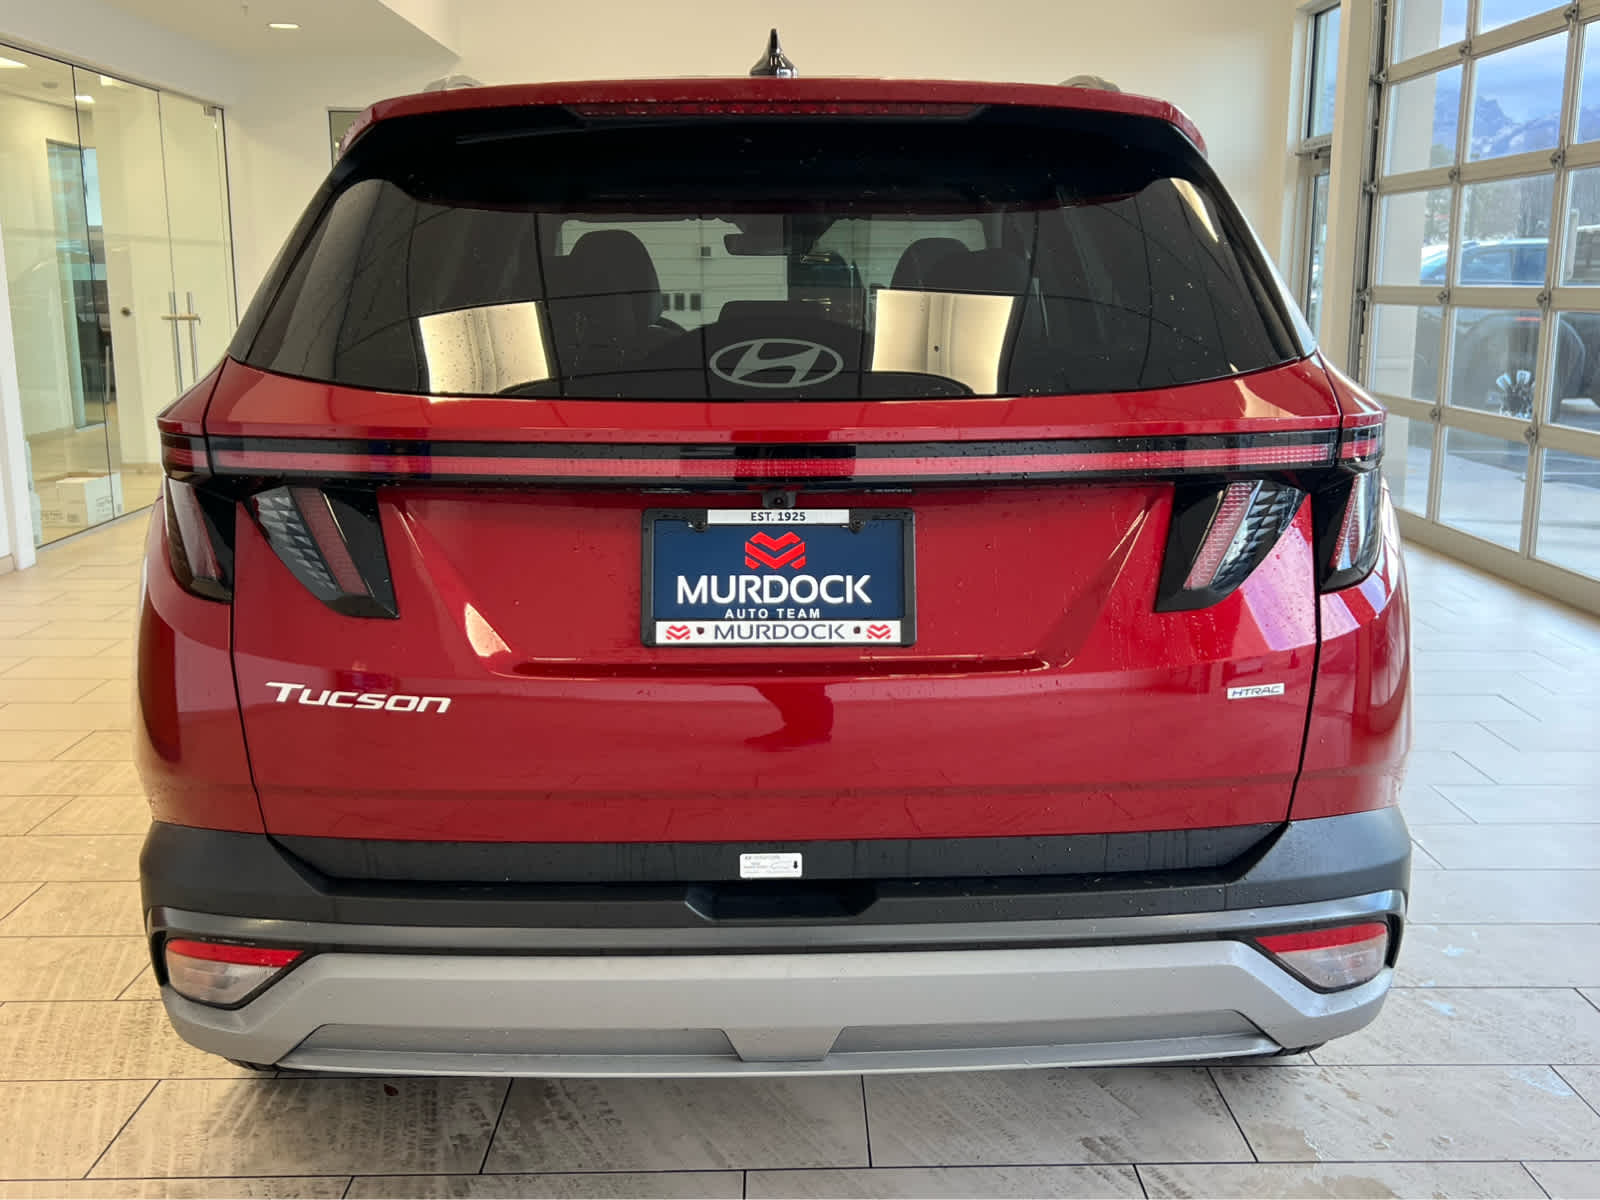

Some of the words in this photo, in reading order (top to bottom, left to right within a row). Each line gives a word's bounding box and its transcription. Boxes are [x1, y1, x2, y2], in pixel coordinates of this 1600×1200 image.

[750, 511, 775, 522] EST.
[777, 511, 807, 522] 1925
[676, 574, 872, 605] MURDOCK
[724, 608, 769, 619] AUTO
[776, 608, 821, 619] TEAM
[714, 623, 846, 641] MURDOCK
[1231, 685, 1282, 697] HTRAC
